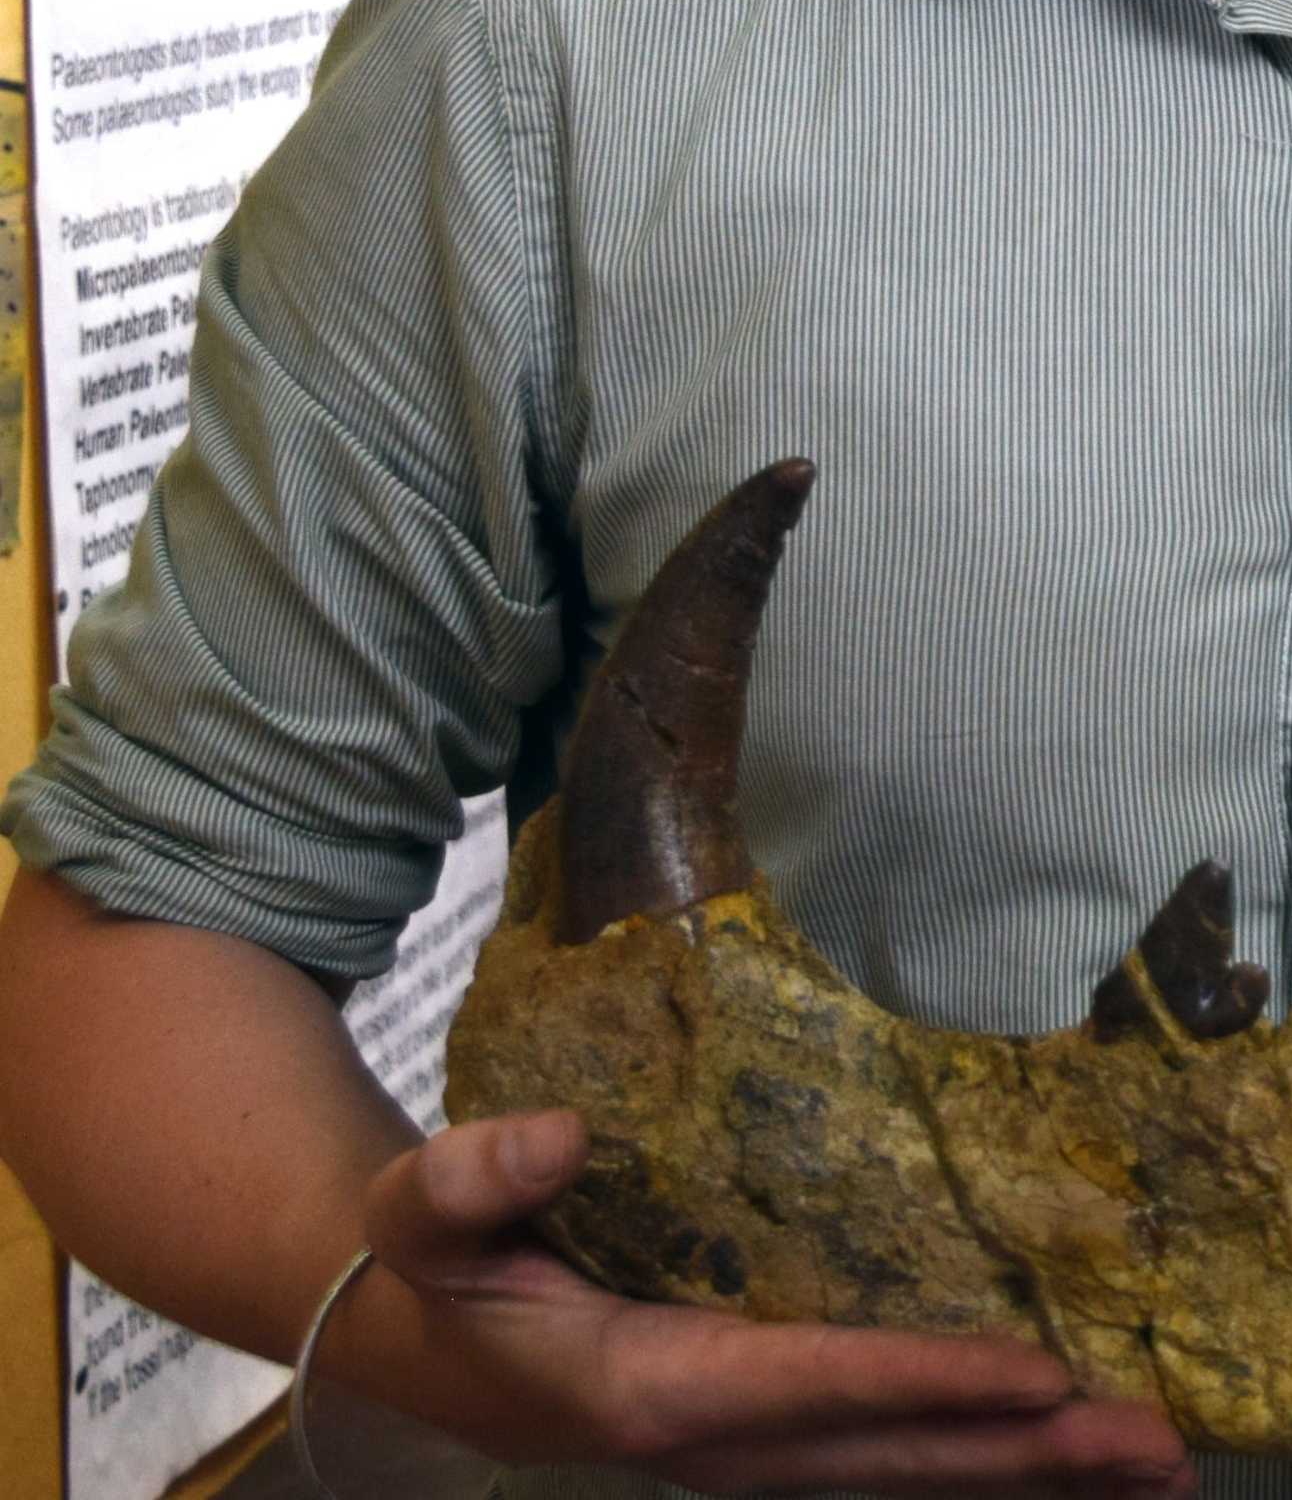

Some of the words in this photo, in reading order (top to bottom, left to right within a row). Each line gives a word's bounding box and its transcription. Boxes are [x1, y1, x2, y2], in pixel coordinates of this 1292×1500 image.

[50, 40, 168, 90] Palaeontologists
[169, 30, 203, 71] study
[51, 103, 94, 146] Some
[96, 80, 204, 142] palaeontologists
[61, 205, 149, 254] Paleontology
[151, 196, 164, 229] is
[78, 304, 169, 358] Invertebrate
[78, 358, 154, 410] Vertebrate
[73, 421, 126, 465] Human
